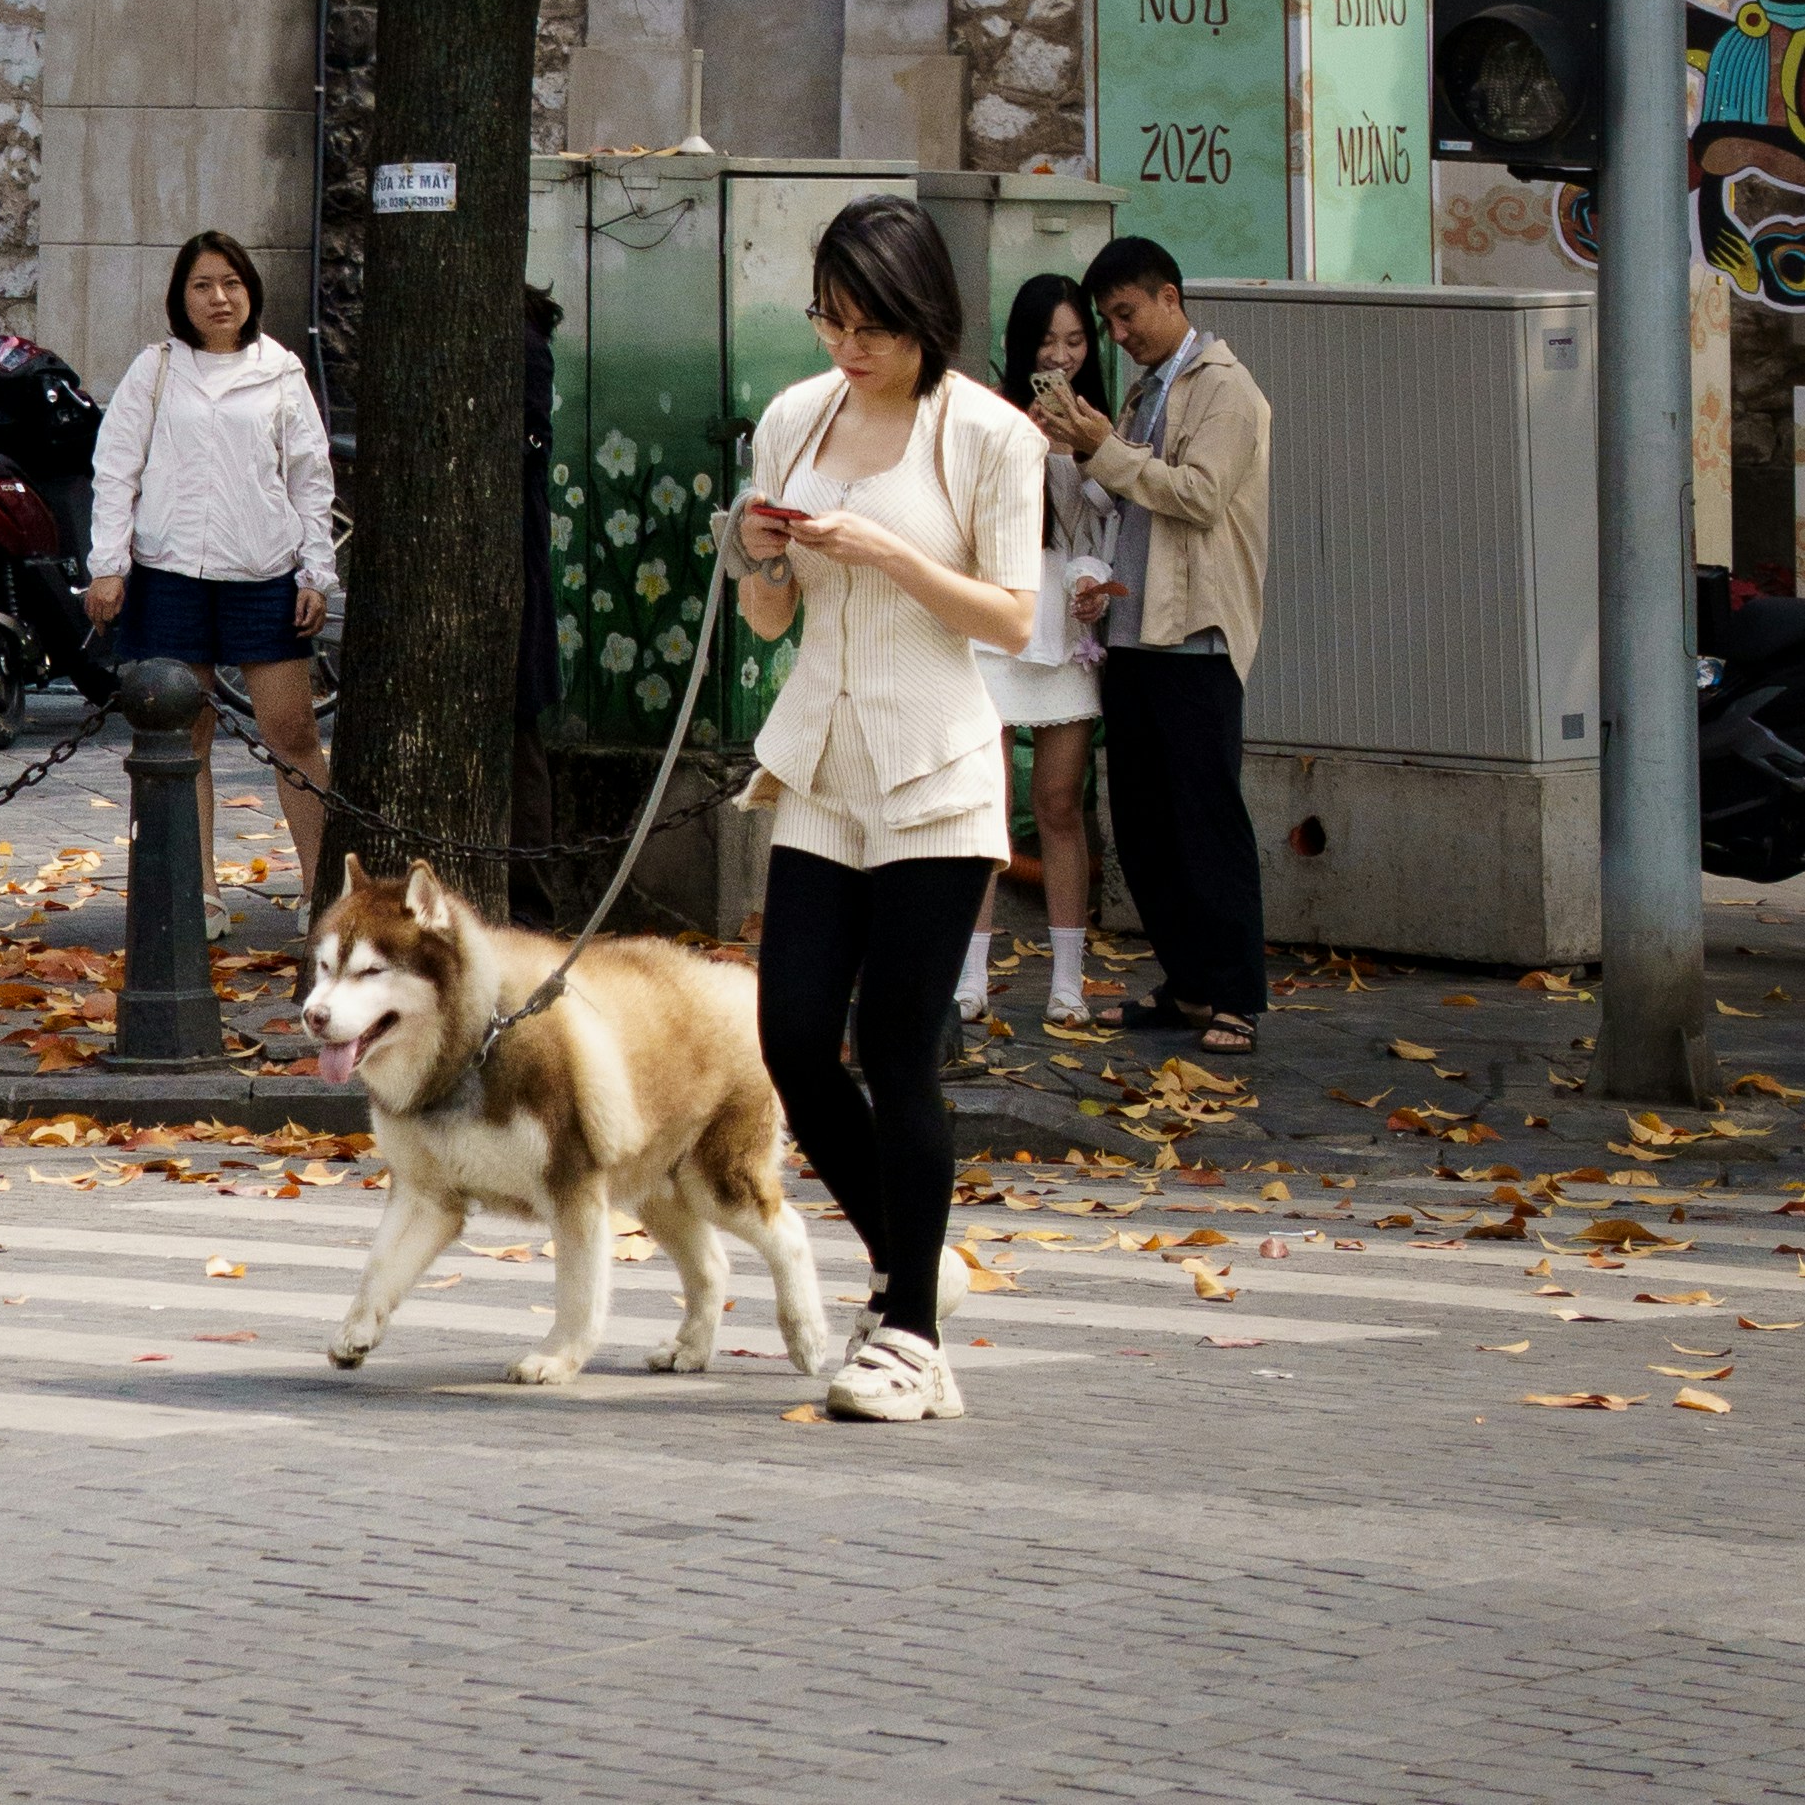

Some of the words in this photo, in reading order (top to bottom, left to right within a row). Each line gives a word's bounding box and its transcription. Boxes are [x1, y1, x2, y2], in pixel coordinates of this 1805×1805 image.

[1139, 122, 1232, 185] 2026
[1337, 110, 1411, 187] MỪNG
[398, 175, 414, 190] XE
